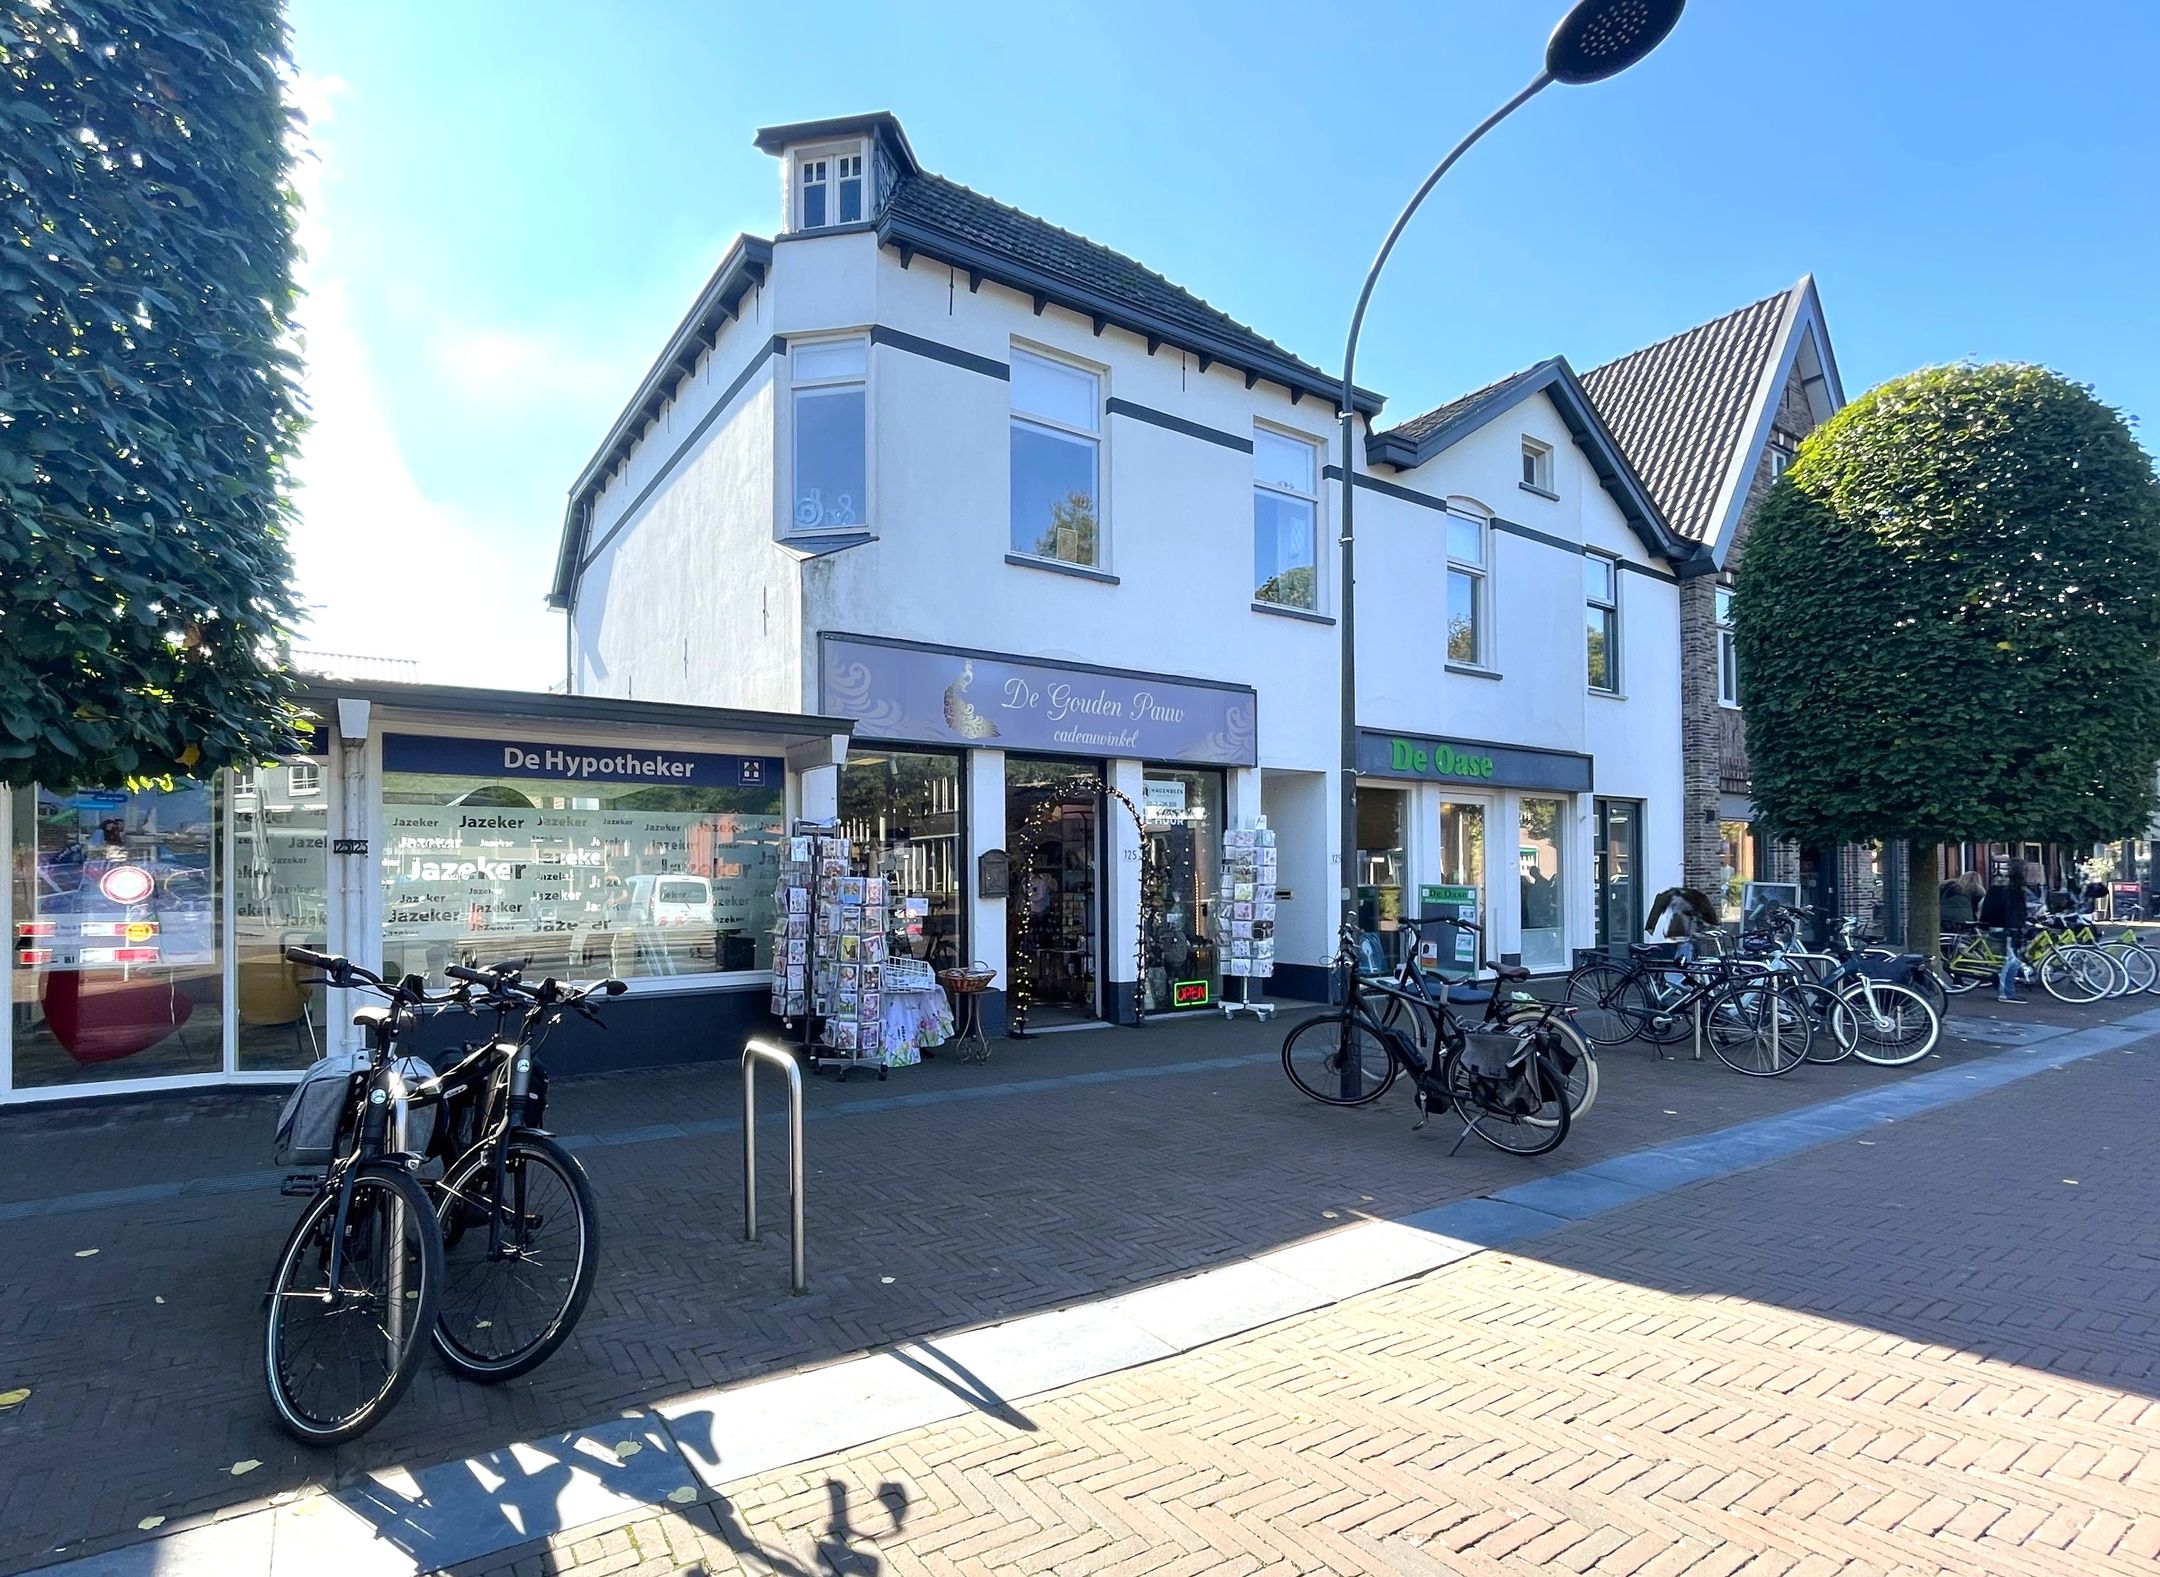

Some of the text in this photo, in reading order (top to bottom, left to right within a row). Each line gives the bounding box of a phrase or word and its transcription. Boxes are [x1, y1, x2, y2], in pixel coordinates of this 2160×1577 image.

[1001, 677, 1184, 724] De Gouden Pauw
[1053, 723, 1140, 749] cadeauwinkel
[503, 747, 695, 778] De Hypotheker
[1391, 738, 1494, 778] De Oase
[392, 817, 439, 827] Jazeker
[459, 815, 524, 828] Jazeker
[536, 816, 588, 827] Jazeker
[644, 823, 682, 832] Jazeker
[399, 836, 462, 849] Jazeker
[271, 856, 307, 864] Jazeker
[1124, 850, 1137, 860] 125
[408, 856, 526, 880] Jazeker
[400, 893, 446, 903] Jazeker
[388, 908, 460, 923] Jazeker
[1177, 985, 1205, 1001] OPEN
